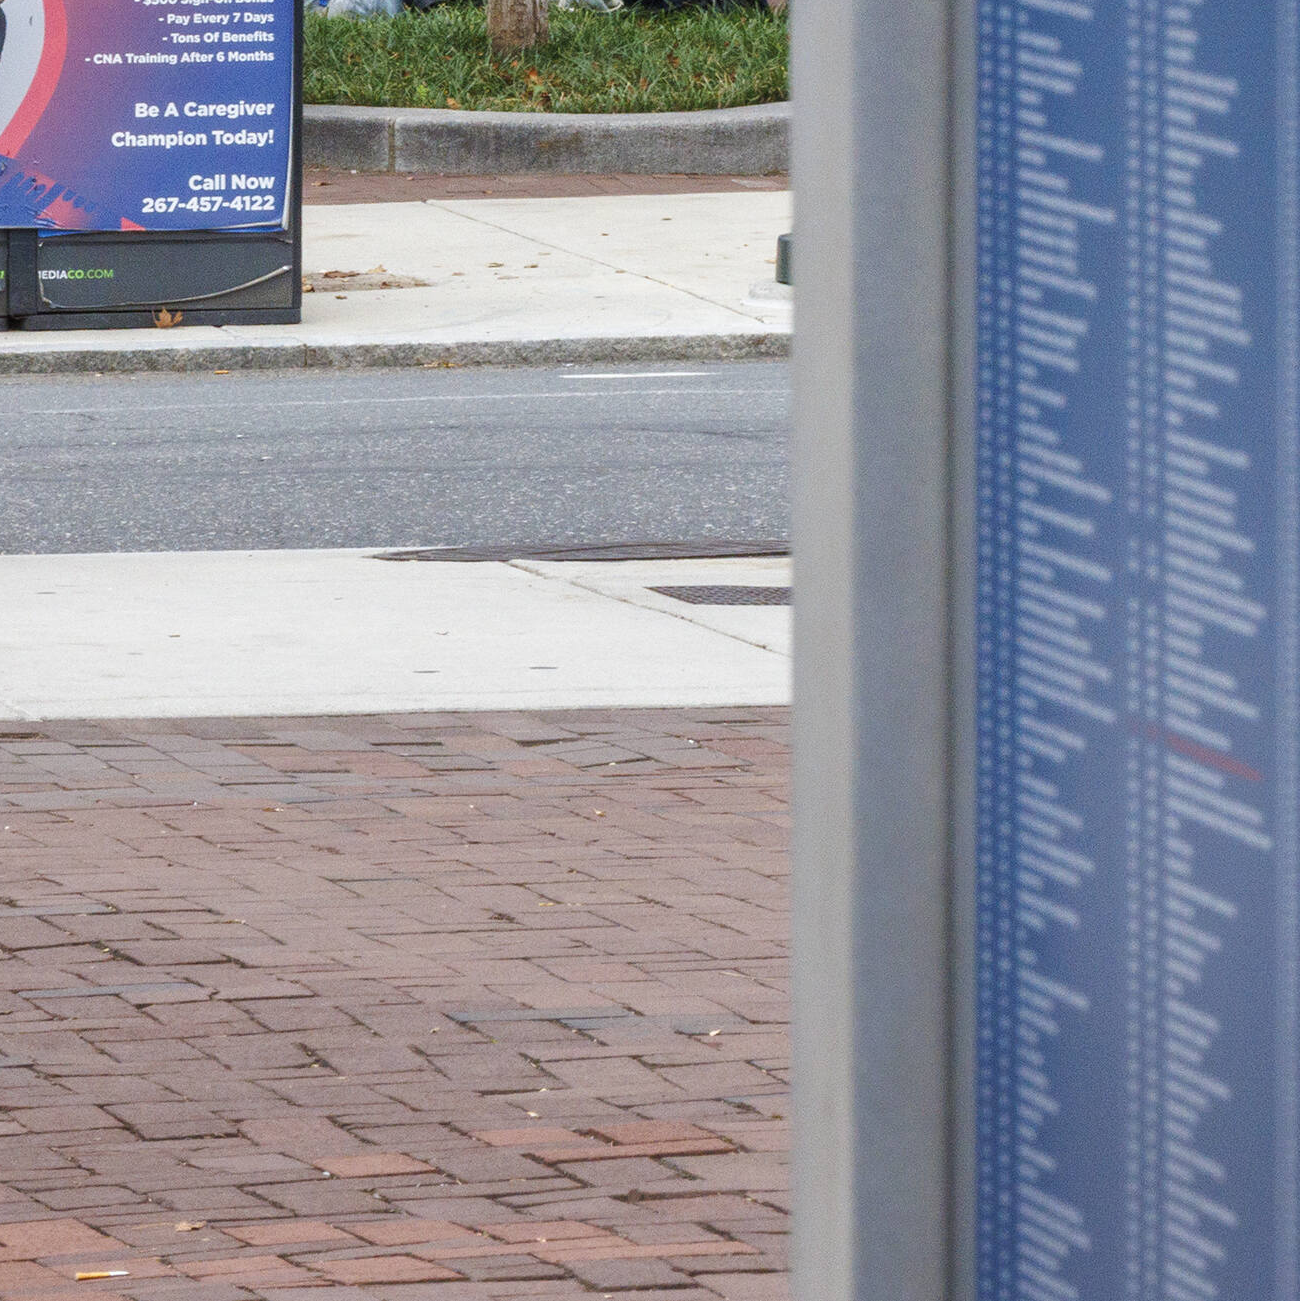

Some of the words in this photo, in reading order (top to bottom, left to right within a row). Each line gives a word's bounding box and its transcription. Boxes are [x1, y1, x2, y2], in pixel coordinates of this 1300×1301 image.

[167, 13, 190, 25] Pay
[193, 13, 229, 25] Every
[233, 13, 241, 22] 7
[243, 12, 274, 25] Days
[170, 33, 200, 43] Tons
[203, 32, 219, 43] Of
[222, 31, 274, 42] Benefits
[93, 53, 122, 64] CNA
[125, 53, 177, 65] Training
[180, 51, 213, 63] After
[216, 51, 225, 62] 6
[227, 50, 274, 62] Months
[135, 102, 159, 117] Be
[164, 102, 179, 117] A
[184, 100, 275, 119] Caregiver
[111, 131, 207, 149] Champion
[211, 129, 274, 147] Today!
[188, 174, 225, 190] Call
[231, 174, 275, 190] Now
[142, 195, 275, 213] 267-457-4122
